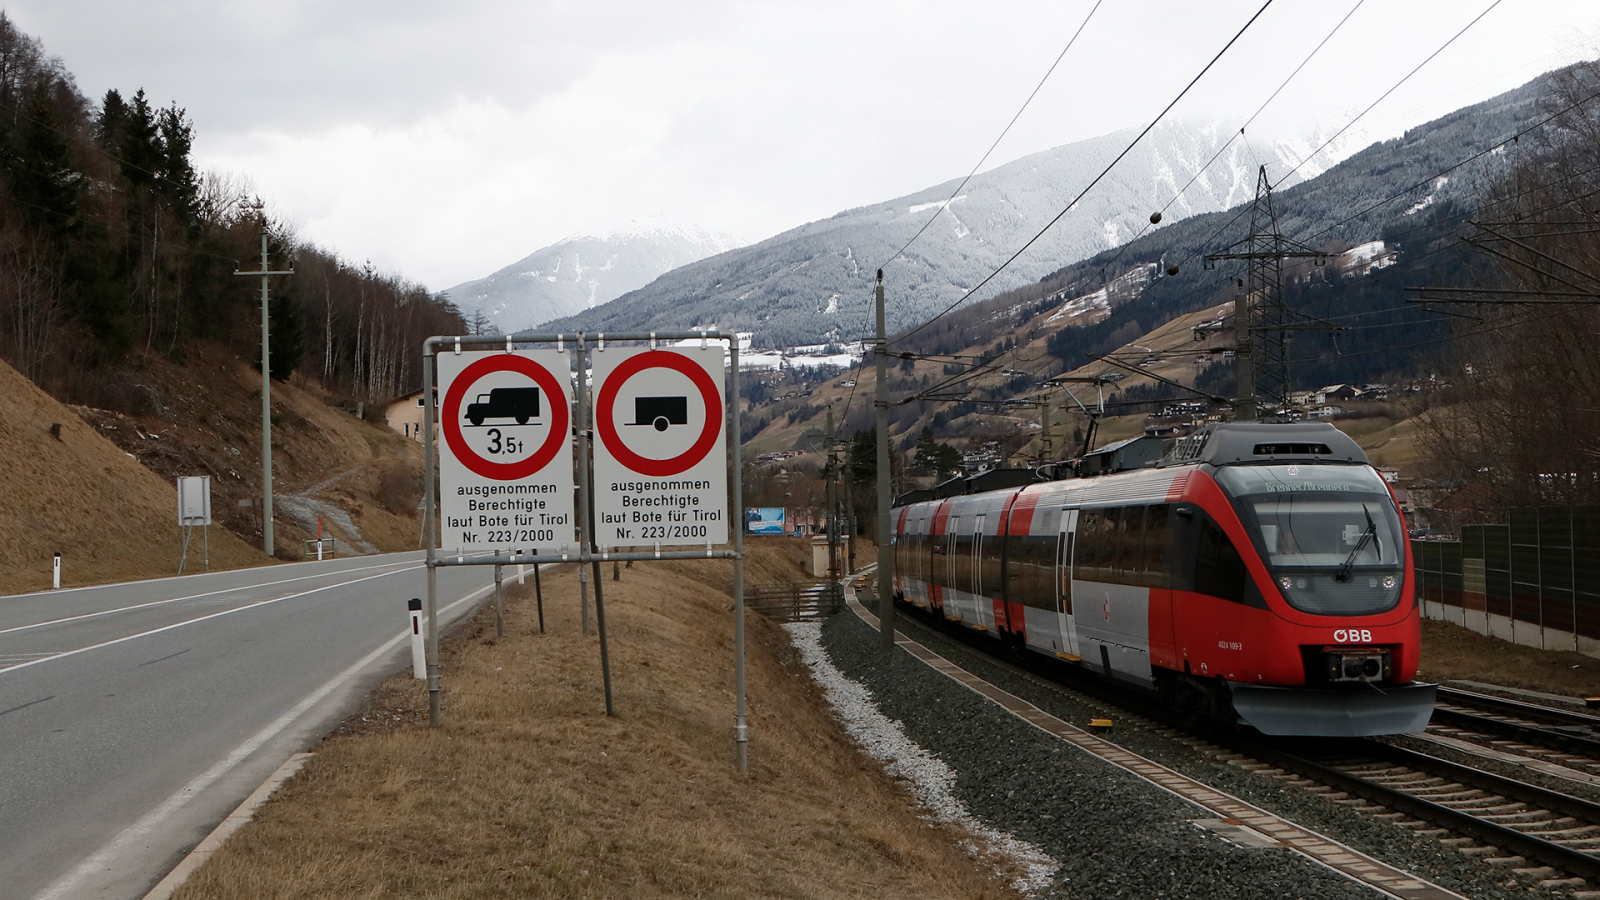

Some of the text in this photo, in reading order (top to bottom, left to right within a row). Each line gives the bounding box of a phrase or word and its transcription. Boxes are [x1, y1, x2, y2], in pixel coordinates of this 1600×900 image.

[457, 484, 557, 498] ausgenommen
[611, 480, 710, 494] ausgenommen
[469, 498, 546, 513] Berechtigte
[622, 494, 700, 508] Berechtigte
[447, 513, 568, 528] laut Bote für Tirol
[601, 509, 721, 523] laut Bote für Tirol
[463, 529, 554, 543] Nr. 223/2000
[616, 525, 707, 539] Nr. 223/2000
[1218, 640, 1243, 651] 4024 109-3
